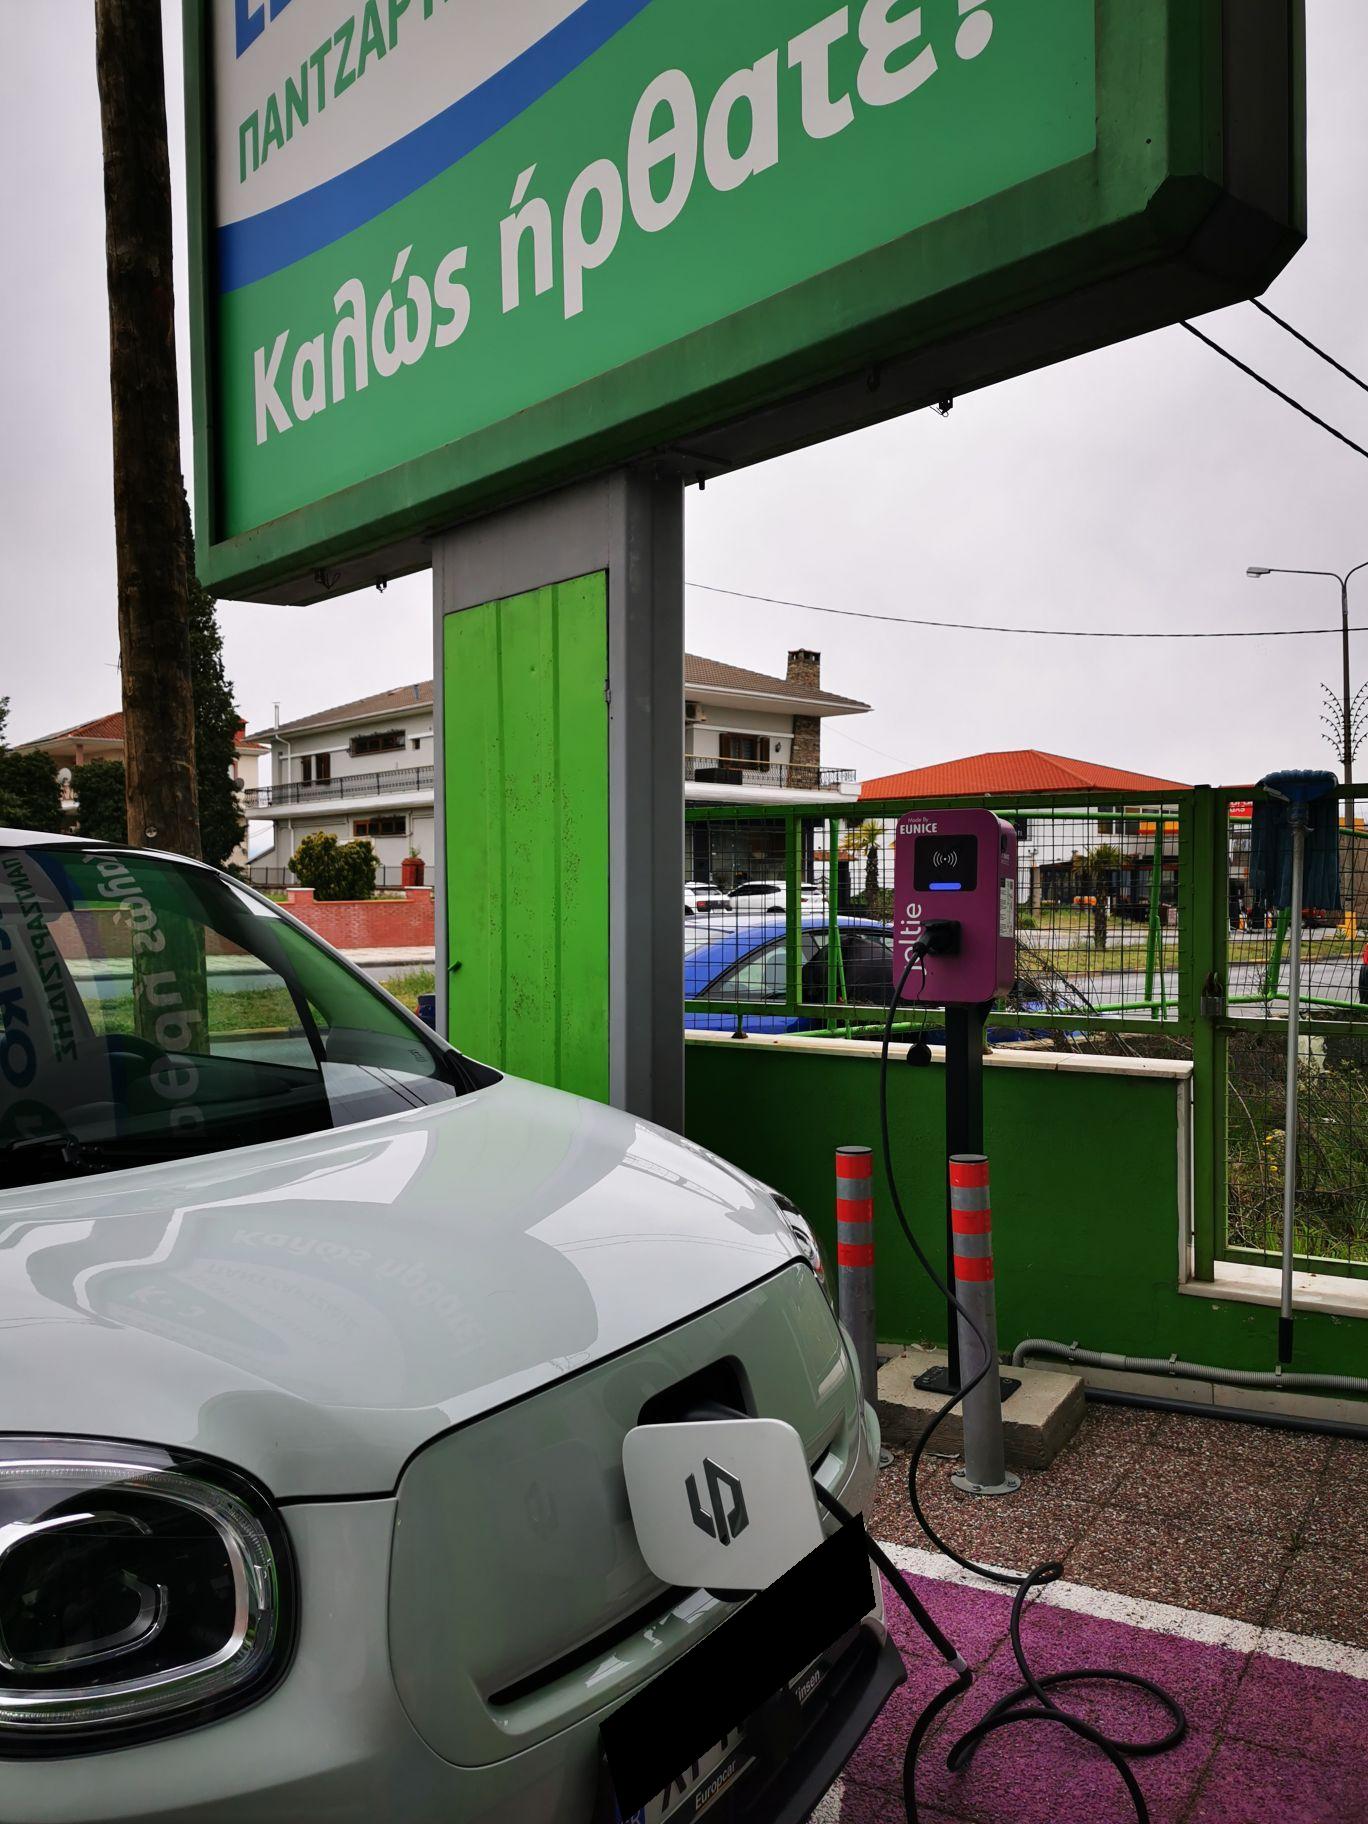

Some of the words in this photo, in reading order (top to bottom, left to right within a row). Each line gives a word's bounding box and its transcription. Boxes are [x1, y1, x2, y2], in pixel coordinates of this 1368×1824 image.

[238, 0, 451, 184] ΠΑΝΤΖΑΡ
[254, 244, 471, 445] Καλώς
[900, 823, 938, 835] EUNICE
[695, 1758, 738, 1810] Europcar
